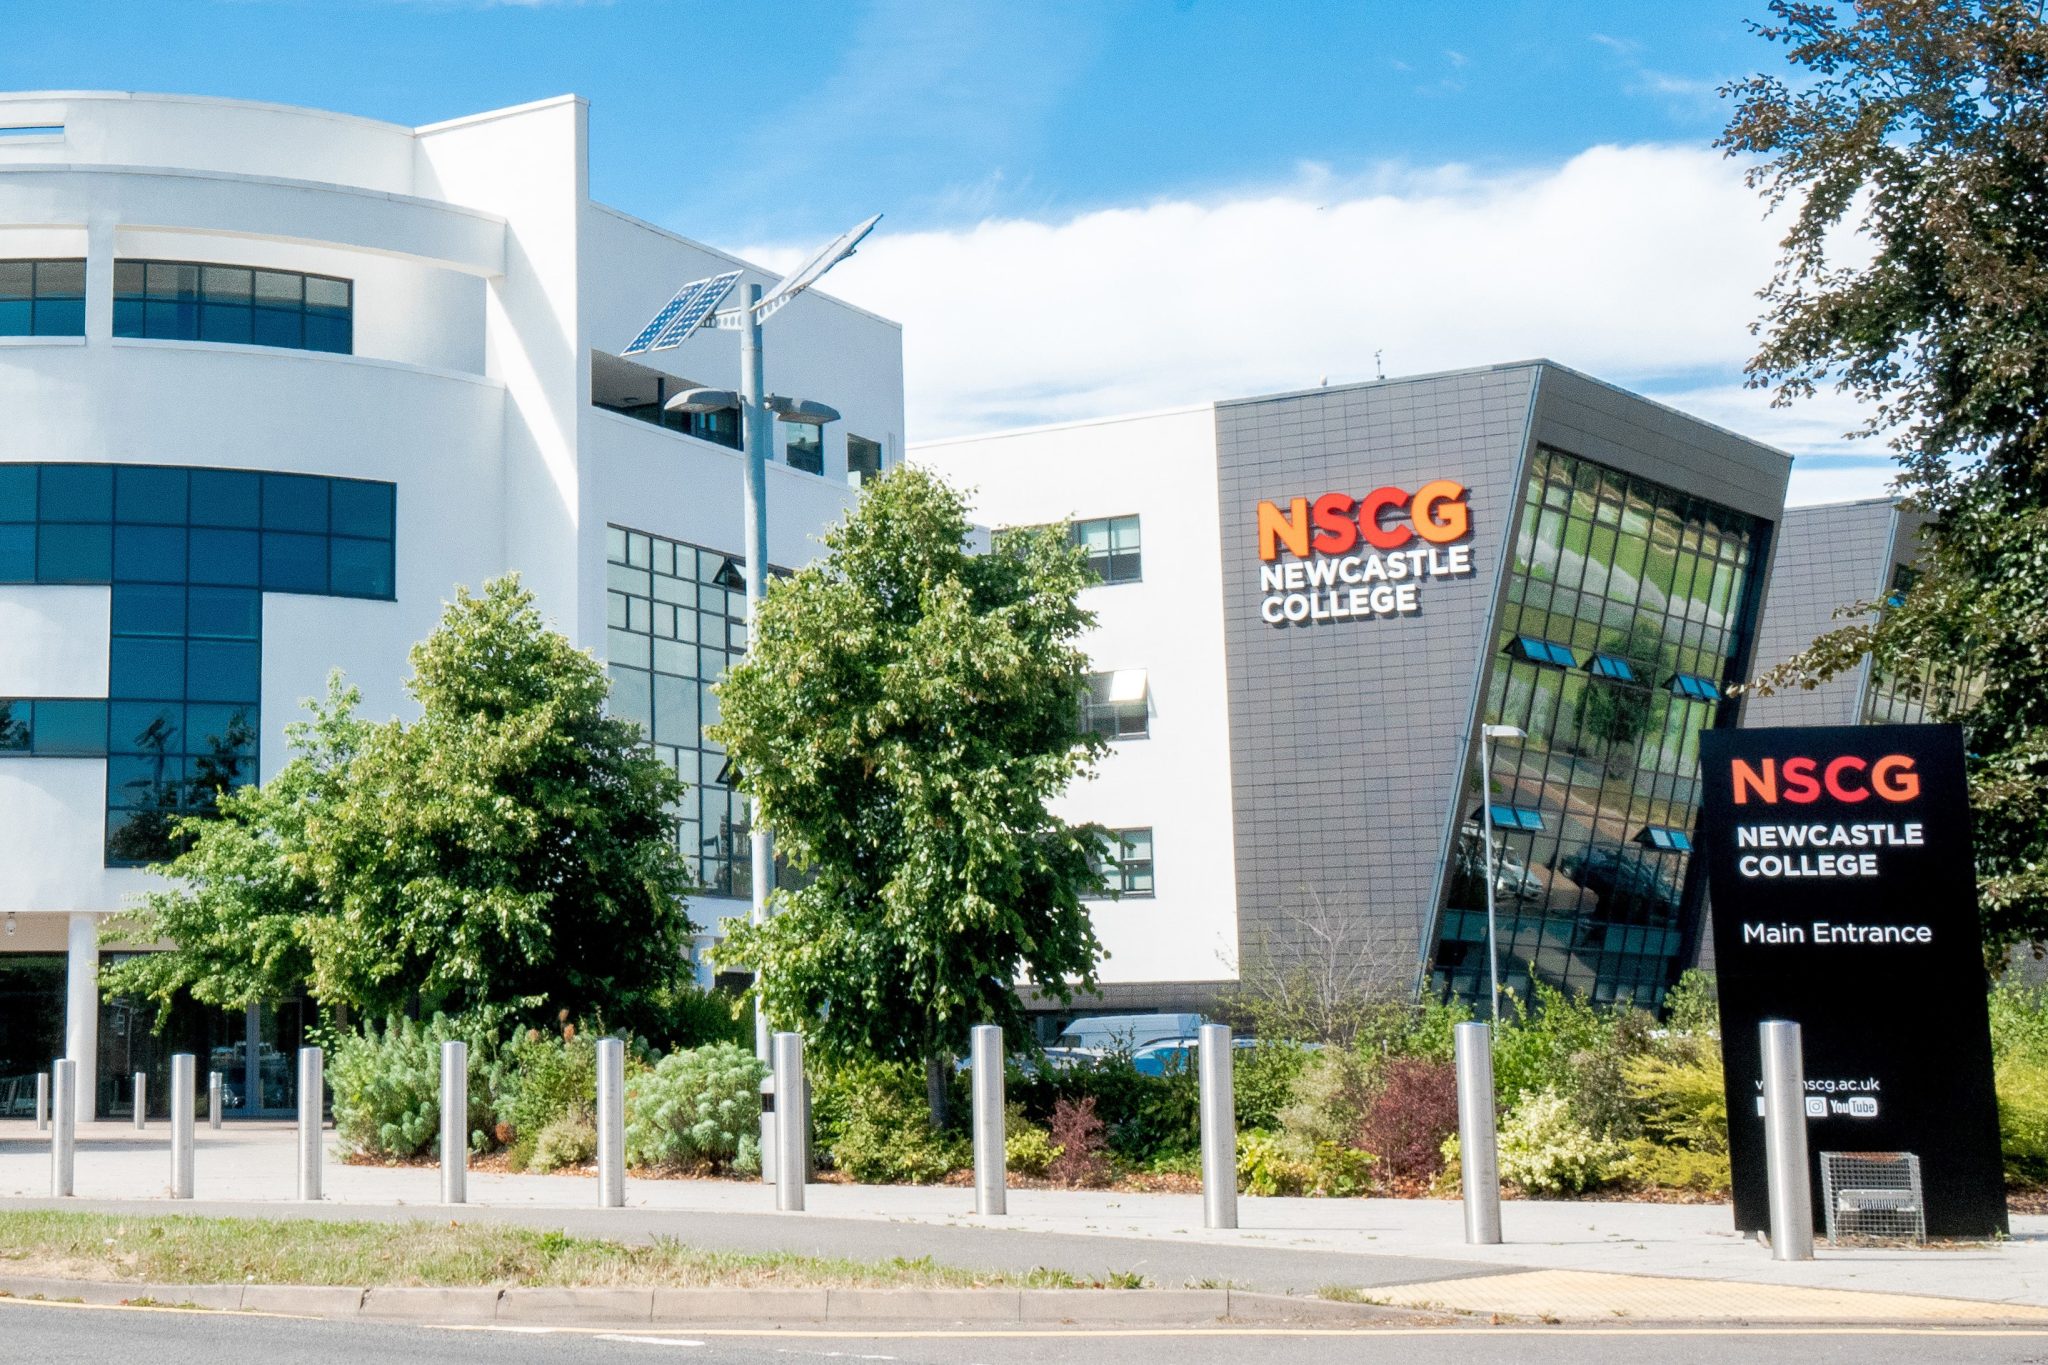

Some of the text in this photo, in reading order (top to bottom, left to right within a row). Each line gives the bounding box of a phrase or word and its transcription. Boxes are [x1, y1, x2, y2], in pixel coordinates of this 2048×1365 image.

[1257, 480, 1469, 560] NSCG
[1260, 545, 1470, 592] NEWCASTLE
[1261, 583, 1418, 623] COLLEGE
[1731, 754, 1921, 805] NSCG
[1737, 823, 1924, 847] NEWCASTLE
[1739, 854, 1878, 877] COLLEGE
[1743, 922, 1932, 944] Main Entrance
[1829, 1098, 1878, 1116] YouTube
